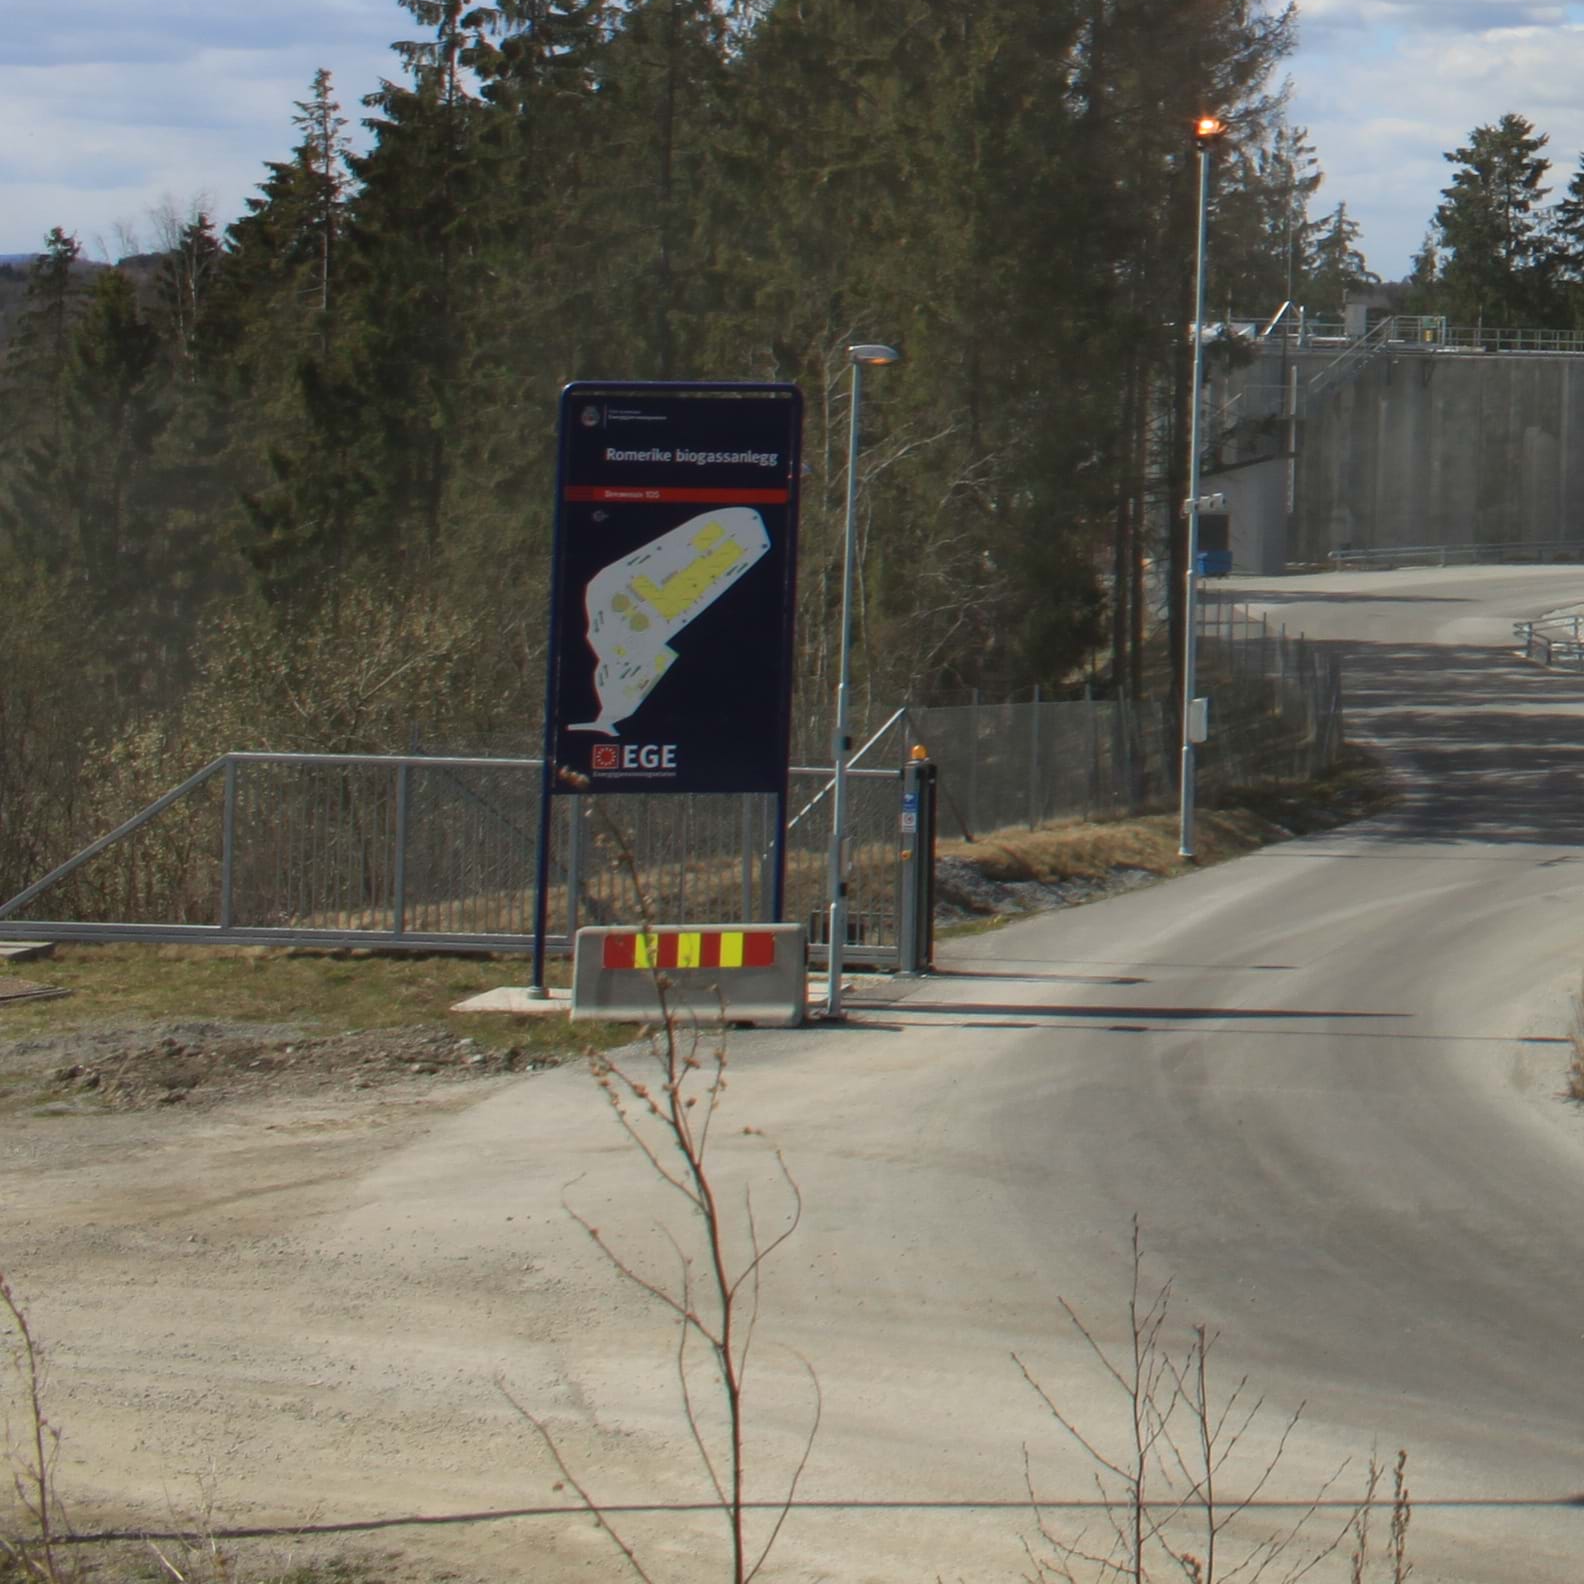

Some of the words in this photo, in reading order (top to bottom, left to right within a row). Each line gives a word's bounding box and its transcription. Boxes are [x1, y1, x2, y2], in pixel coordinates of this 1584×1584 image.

[606, 448, 671, 462] Romerike
[675, 449, 778, 466] biogassanlegg
[623, 744, 677, 768] EGE
